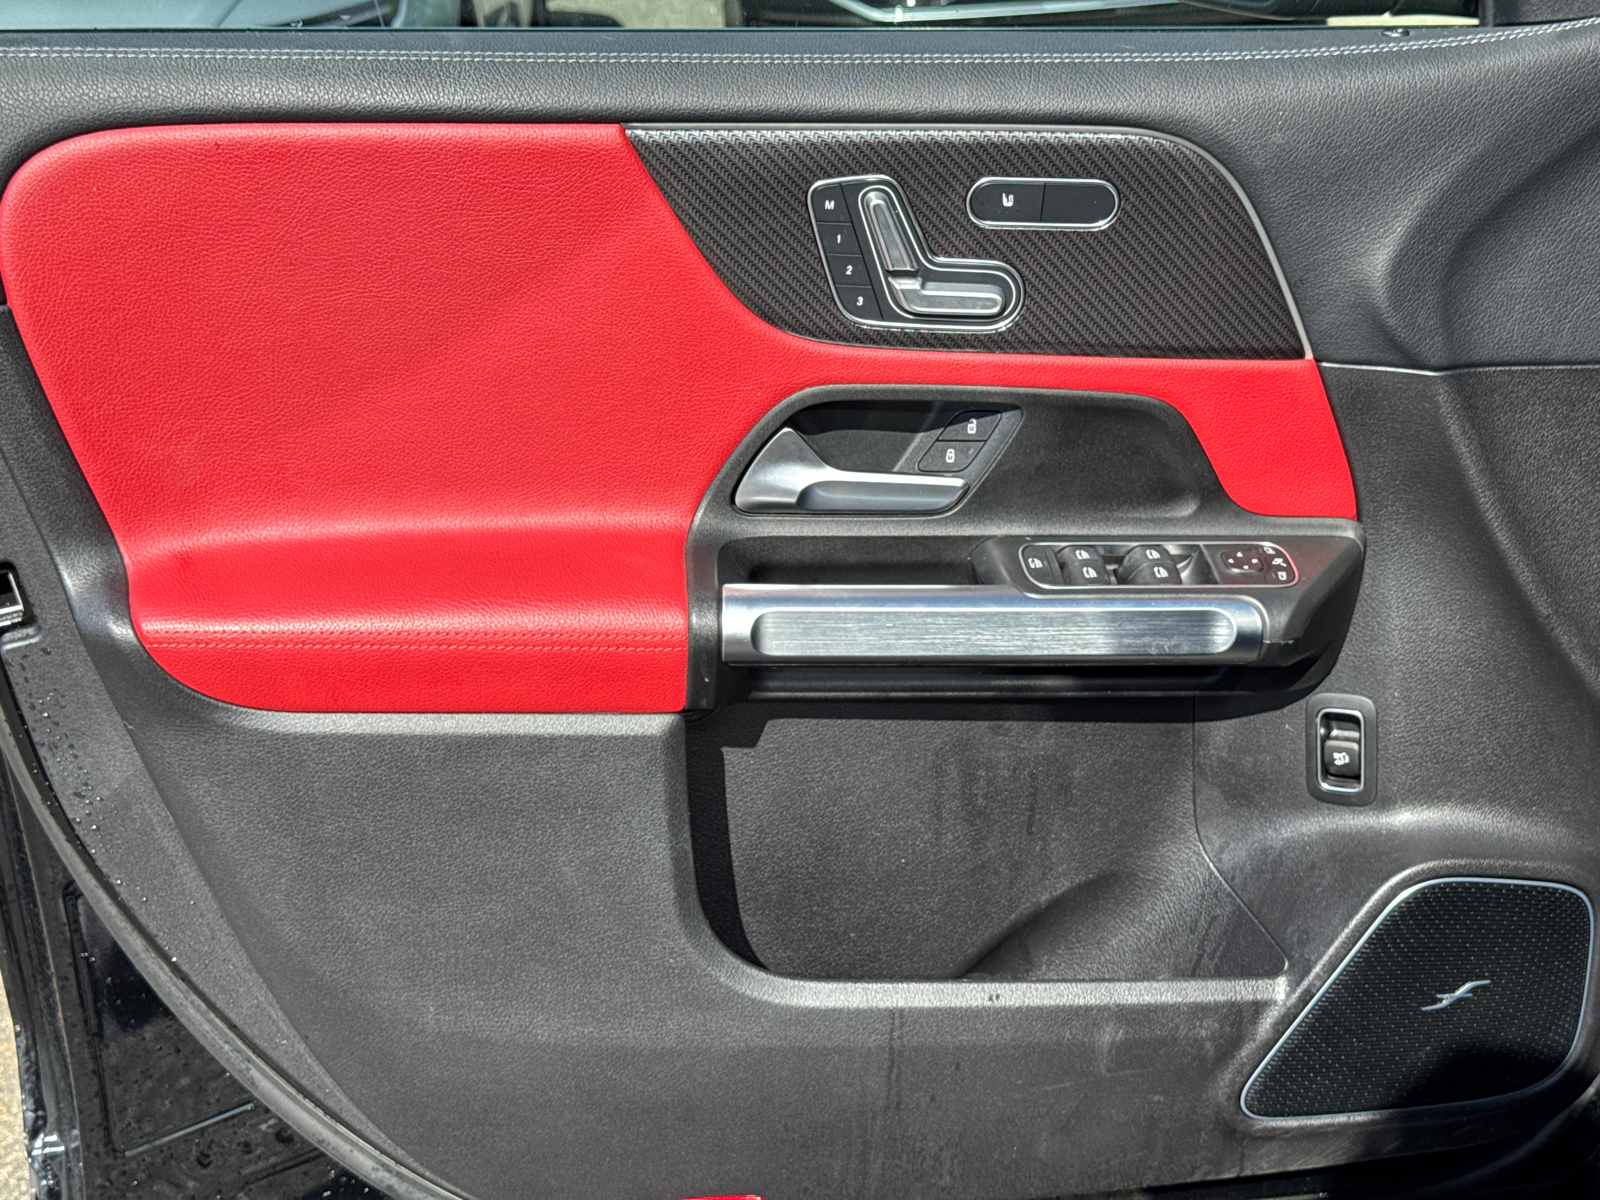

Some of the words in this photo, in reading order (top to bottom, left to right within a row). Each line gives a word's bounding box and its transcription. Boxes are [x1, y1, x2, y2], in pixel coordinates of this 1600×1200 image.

[824, 200, 836, 210] M
[836, 233, 842, 244] 1
[845, 265, 854, 275] 2
[856, 296, 865, 306] 3
